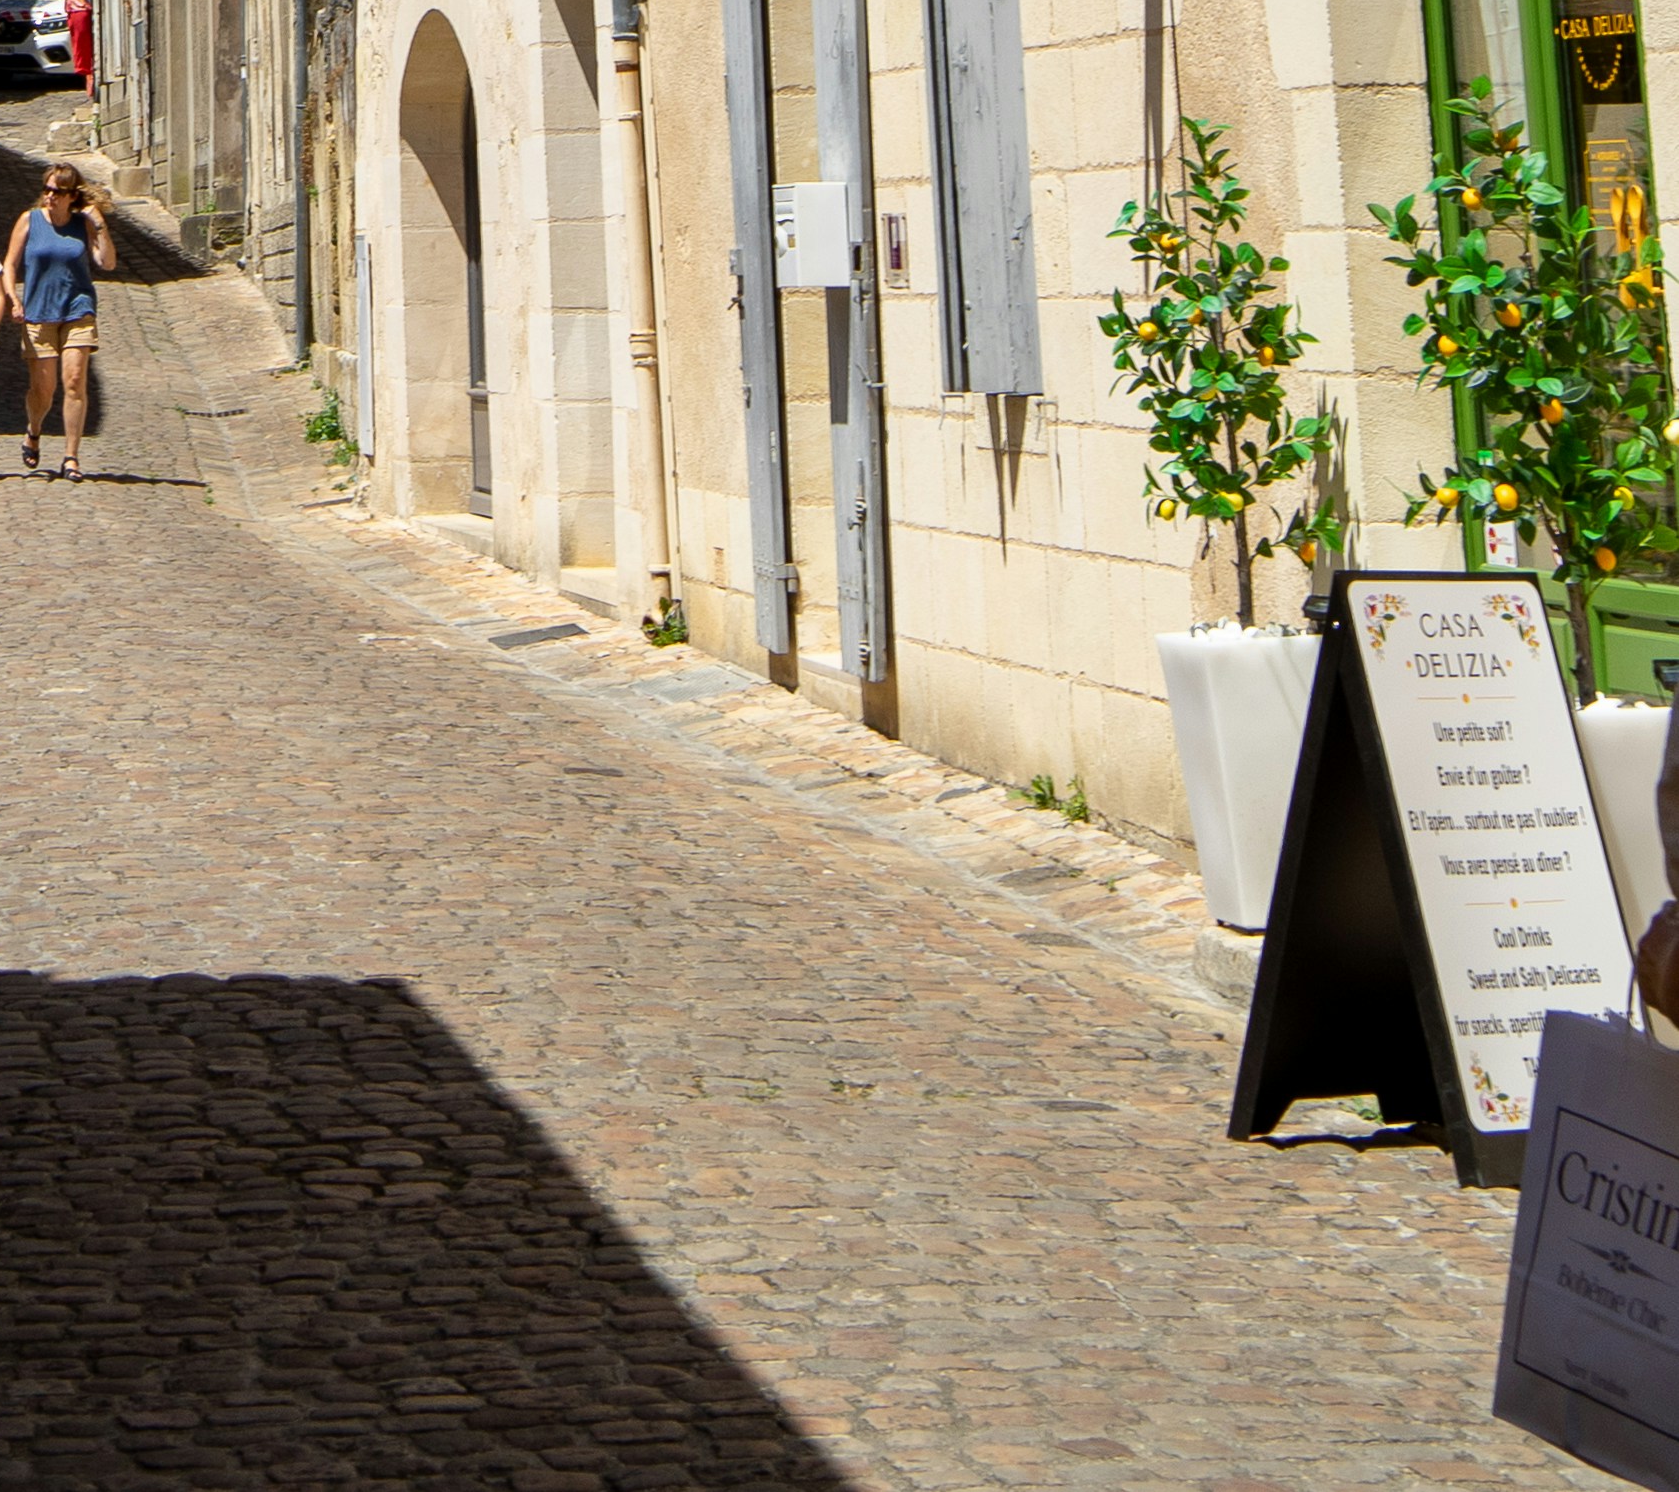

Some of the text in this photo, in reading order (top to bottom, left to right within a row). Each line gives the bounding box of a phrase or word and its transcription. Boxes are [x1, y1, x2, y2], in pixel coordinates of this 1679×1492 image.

[1561, 13, 1636, 39] CASA DELIZIA
[1418, 613, 1484, 638] CASA
[1414, 653, 1507, 678] DELIZIA
[1432, 721, 1456, 742] Une
[1456, 721, 1486, 747] petite
[1486, 720, 1506, 742] soif
[1437, 765, 1466, 786] Envie
[1407, 810, 1422, 831] Et
[1465, 809, 1502, 830] surtout
[1501, 813, 1516, 829] ne
[1516, 812, 1537, 833] pas
[1439, 854, 1466, 876] Vous
[1466, 858, 1490, 875] avez
[1490, 852, 1521, 879] pensé
[1521, 857, 1536, 873] au
[1493, 925, 1553, 949] Cool Drinks
[1467, 964, 1602, 991] Sweet and Salty Delicacies
[1454, 1015, 1472, 1037] for
